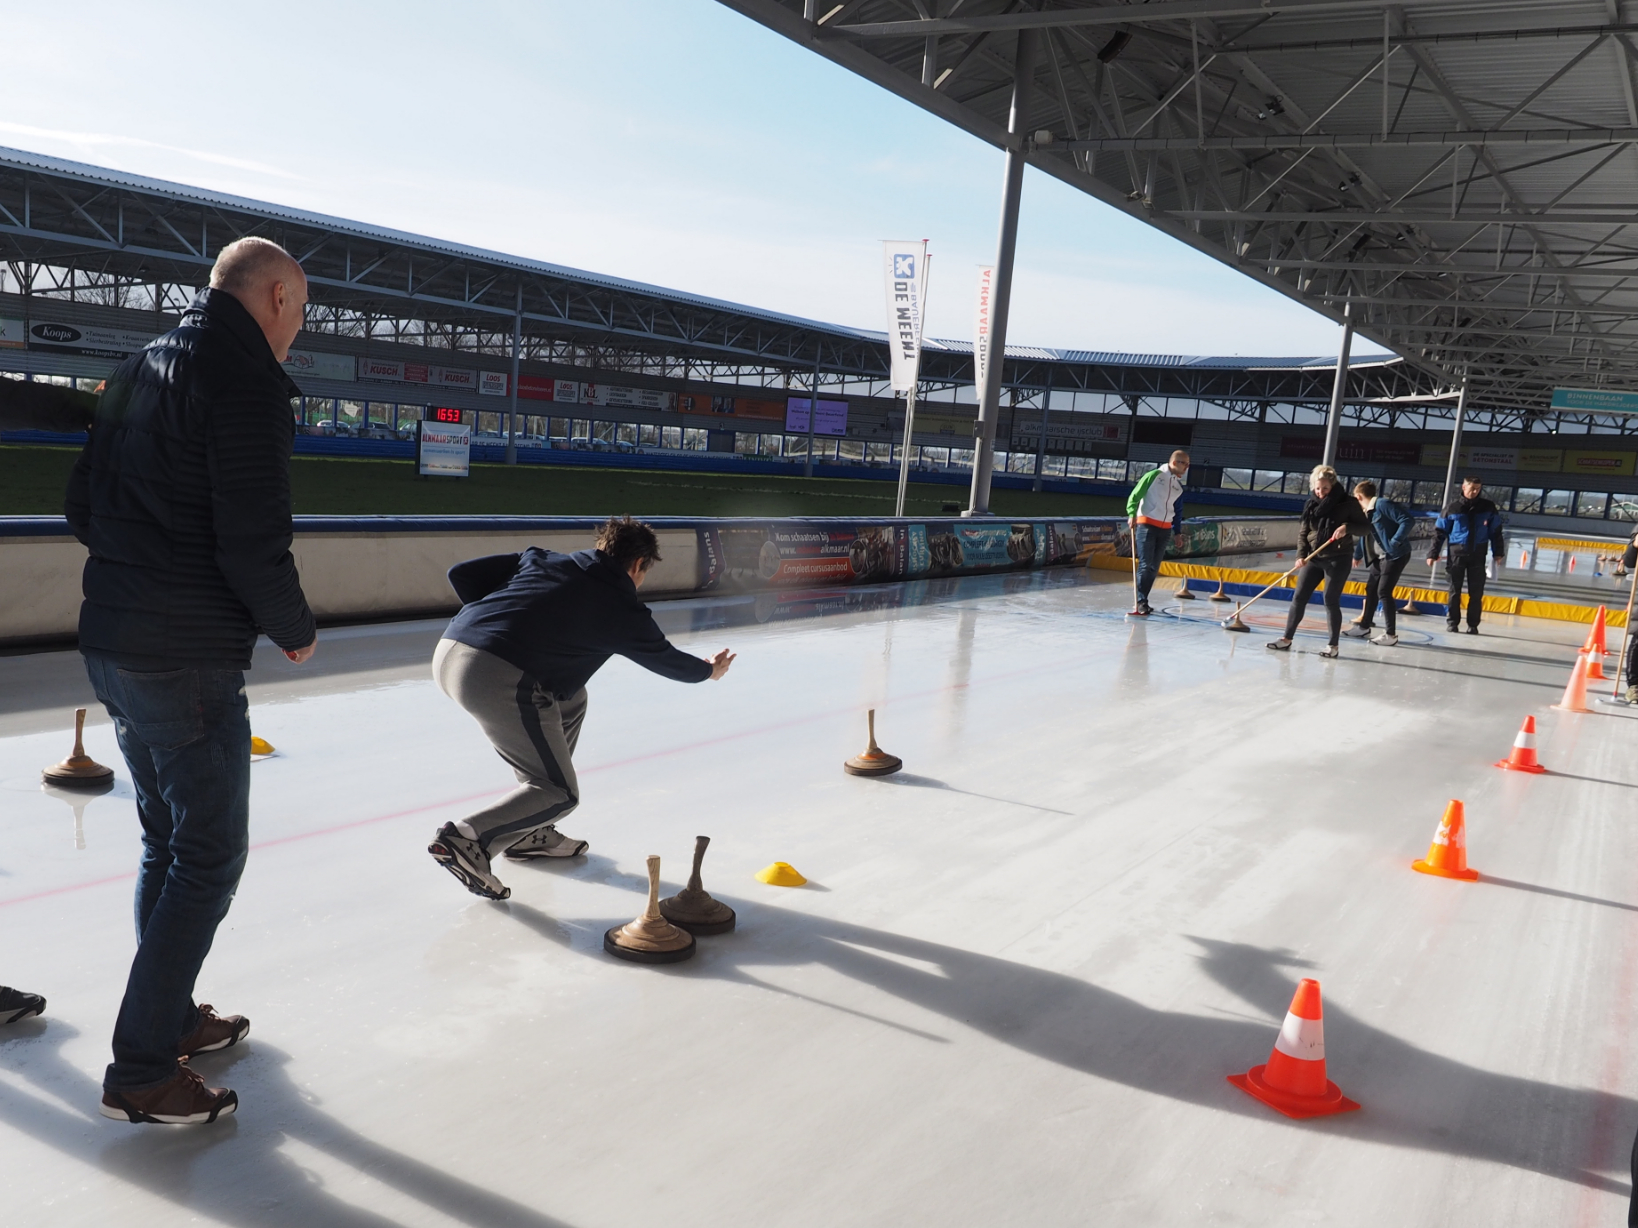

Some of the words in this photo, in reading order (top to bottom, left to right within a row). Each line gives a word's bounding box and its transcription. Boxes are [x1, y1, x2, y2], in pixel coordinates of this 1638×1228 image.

[42, 326, 73, 341] Koops
[370, 365, 398, 376] KUSCH
[444, 373, 470, 383] KUSCH
[1567, 393, 1624, 402] BINNENBAAN
[1025, 423, 1076, 434] alkmarsche
[775, 532, 790, 541] Kom
[791, 532, 820, 541] schaatsen
[820, 532, 829, 543] bij
[703, 531, 717, 574] Balans
[784, 563, 810, 575] Compleet
[810, 562, 848, 573] cursusaanbod
